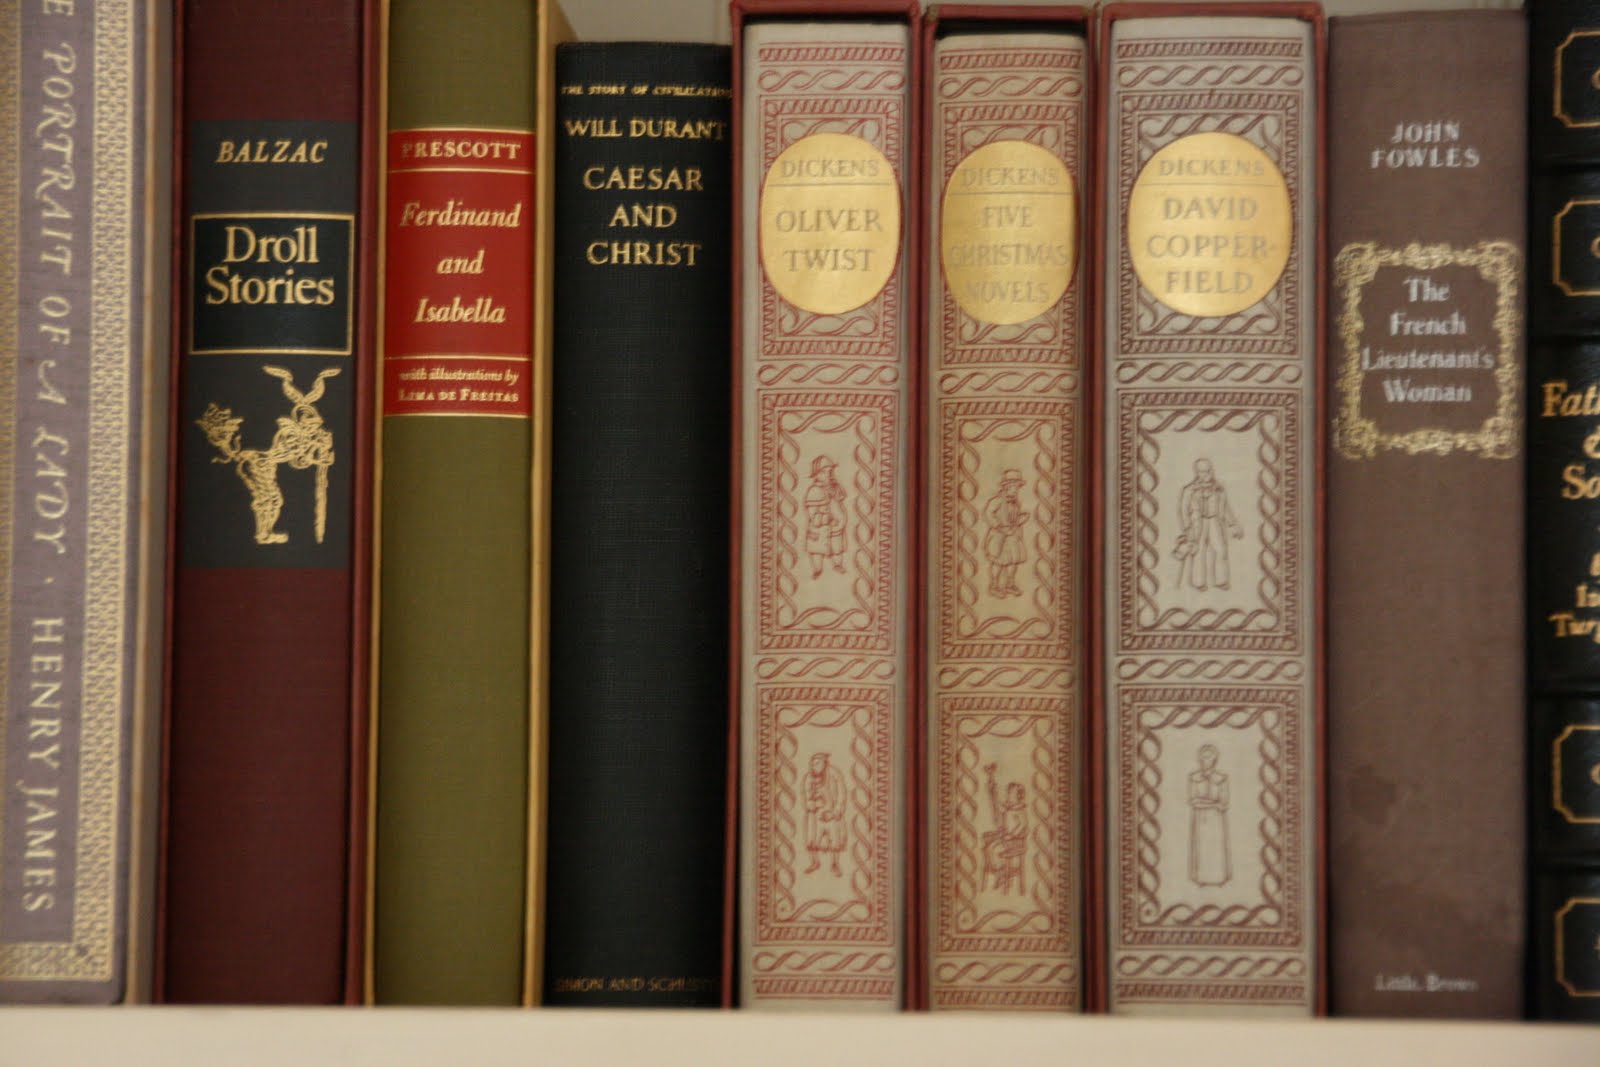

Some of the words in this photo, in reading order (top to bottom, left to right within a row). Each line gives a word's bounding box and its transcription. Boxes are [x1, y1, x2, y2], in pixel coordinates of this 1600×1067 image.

[561, 85, 583, 95] THE
[588, 85, 626, 95] STORY
[631, 85, 648, 95] OF
[565, 119, 623, 137] WILL
[629, 119, 726, 139] DURANT
[1391, 122, 1460, 143] JOHN
[34, 42, 77, 275] PORTRAIT
[215, 140, 328, 163] BALZAC
[401, 141, 521, 159] PRESCOTT
[1370, 147, 1480, 169] FOWLES
[583, 167, 703, 190] CAESAR
[783, 159, 879, 177] DICKENS
[961, 167, 1059, 186] DICKENS
[1159, 159, 1265, 176] DICKENS
[401, 199, 521, 228] Ferdinand
[609, 205, 677, 227] AND
[982, 206, 1033, 228] FIVE
[1164, 197, 1259, 220] DAVID
[776, 210, 882, 232] OLIVER
[222, 226, 319, 263] Droll
[586, 242, 702, 266] CHRIST
[951, 244, 1069, 267] CHRISTMAS
[437, 249, 485, 275] and
[785, 249, 873, 271] TWIST
[206, 266, 335, 304] Stories
[966, 281, 1050, 303] NOVELS
[1165, 271, 1253, 293] FIELD
[1402, 276, 1449, 302] The
[39, 295, 71, 345] OF
[414, 297, 506, 323] Isabella
[1390, 310, 1466, 336] French
[37, 359, 67, 405] A
[429, 368, 503, 381] illustrations
[504, 369, 519, 386] by
[1382, 380, 1473, 403] Woman
[32, 427, 69, 554] LADY
[27, 617, 64, 769] HENRY
[16, 779, 58, 912] JAMES
